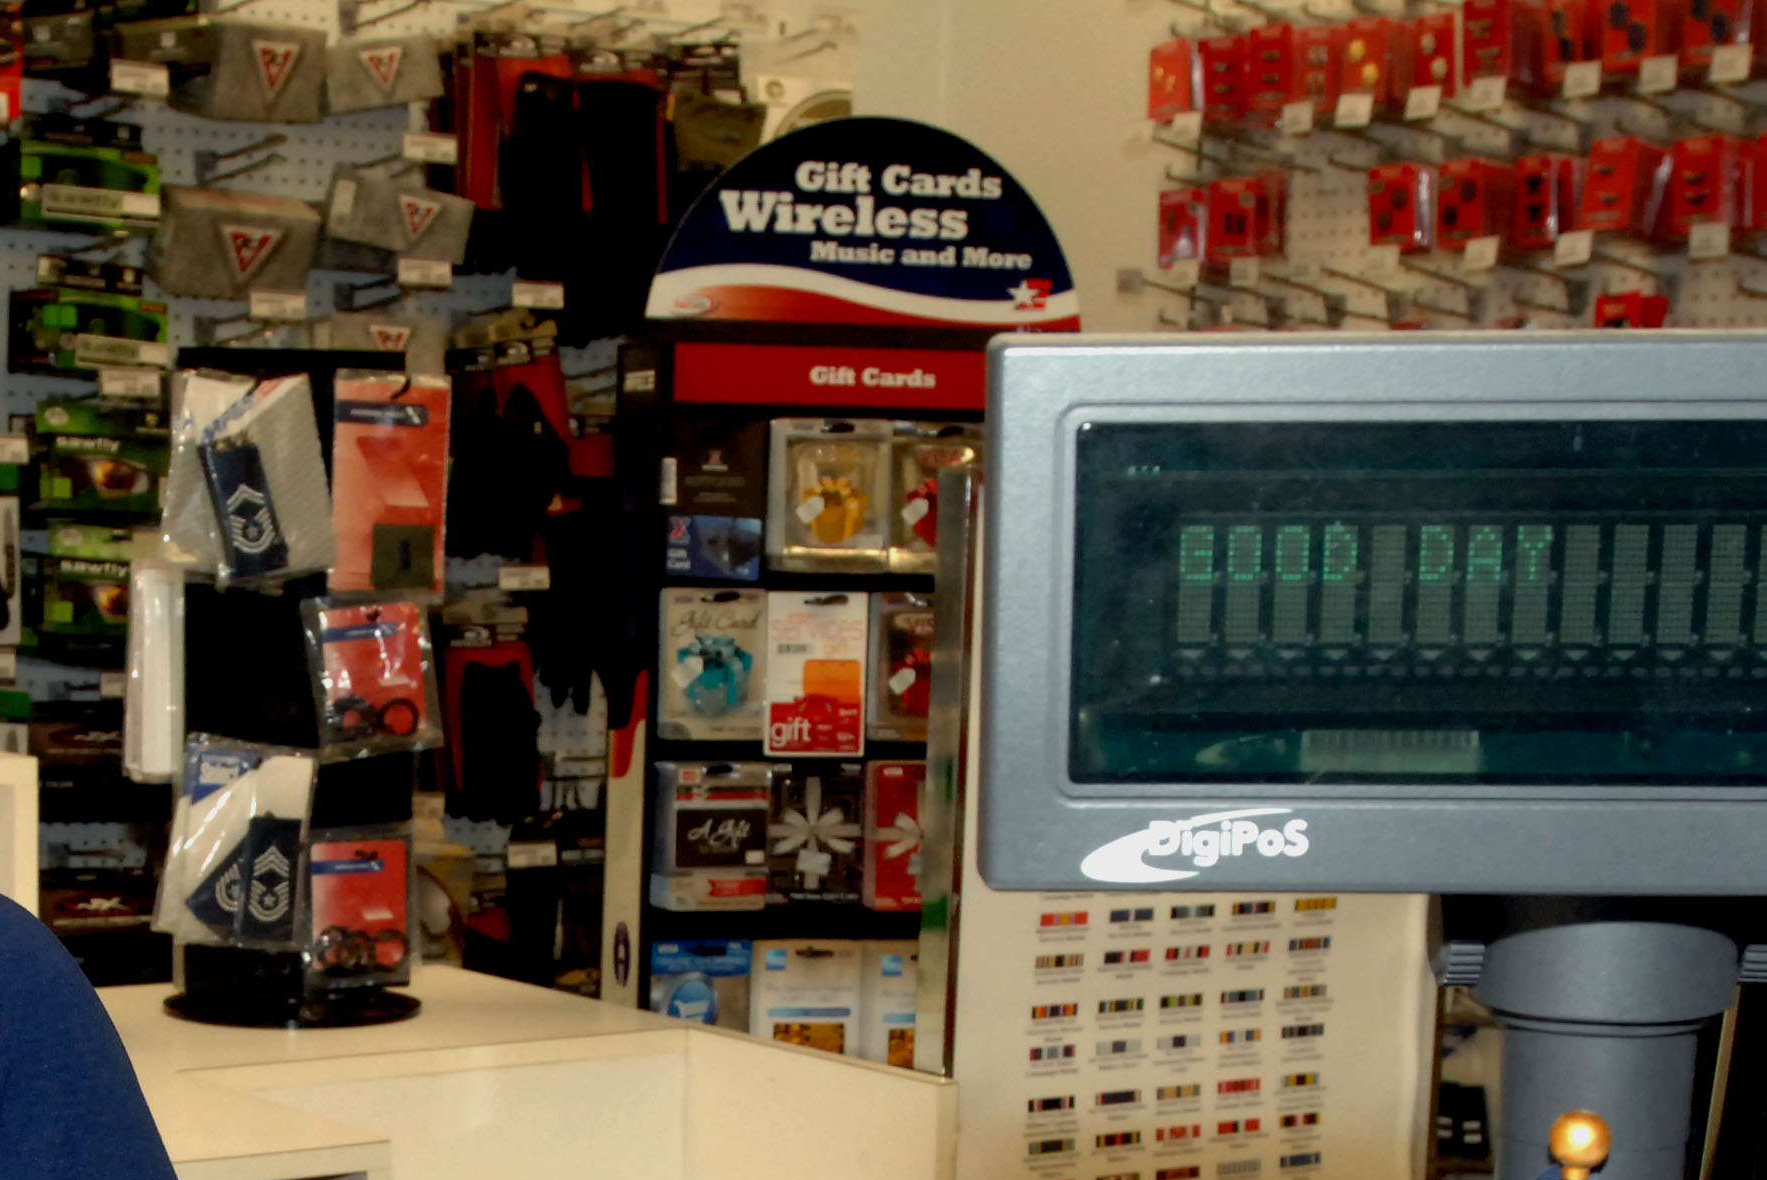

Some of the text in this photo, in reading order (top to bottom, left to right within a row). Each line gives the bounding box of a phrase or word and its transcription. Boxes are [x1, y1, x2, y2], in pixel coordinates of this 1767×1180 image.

[795, 161, 1002, 199] Gift Cards
[719, 189, 969, 240] Wireless
[810, 240, 1033, 271] Music and More
[809, 365, 936, 388] Gift Cards
[1179, 524, 1554, 582] GOOD DAY
[770, 716, 812, 749] gift
